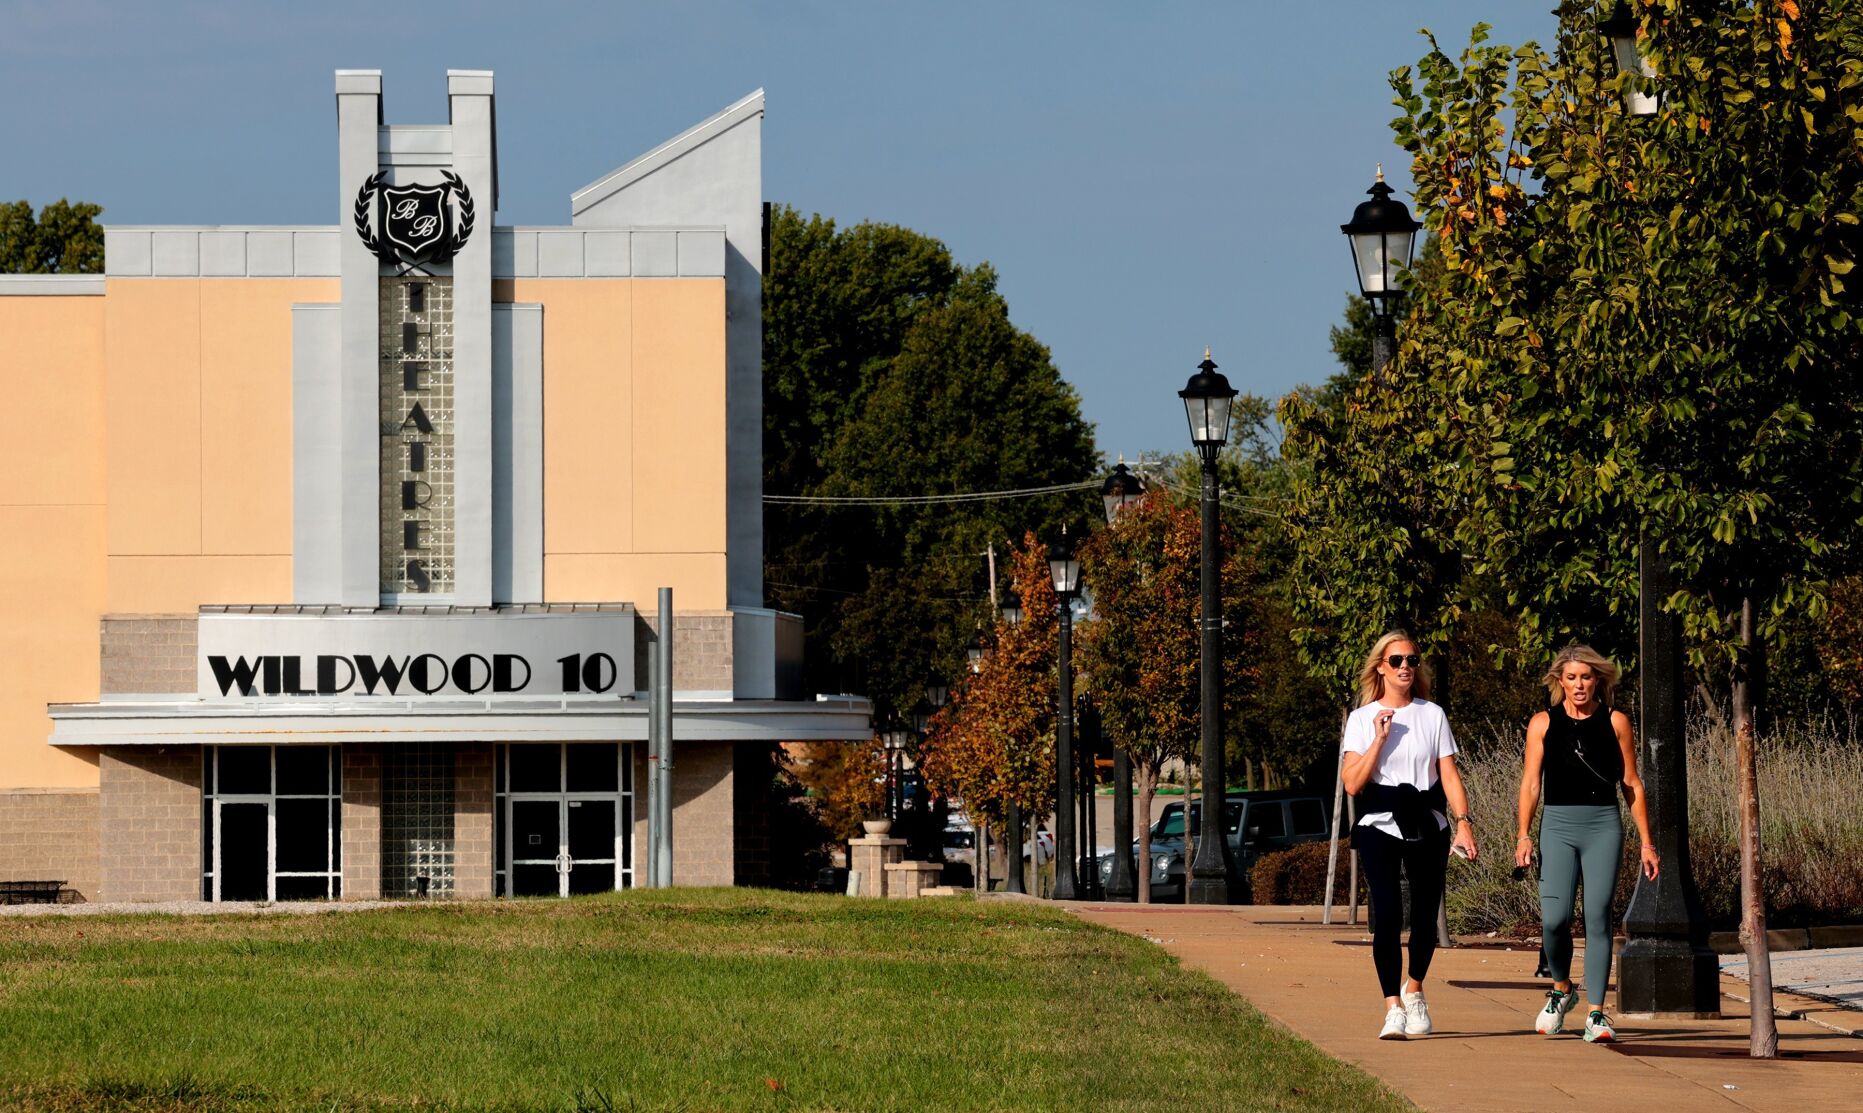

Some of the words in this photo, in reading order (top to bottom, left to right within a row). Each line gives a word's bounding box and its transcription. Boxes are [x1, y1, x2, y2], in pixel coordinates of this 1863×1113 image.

[399, 282, 434, 592] THEATRES
[208, 653, 531, 696] WILDWOOD
[557, 652, 617, 693] 10
